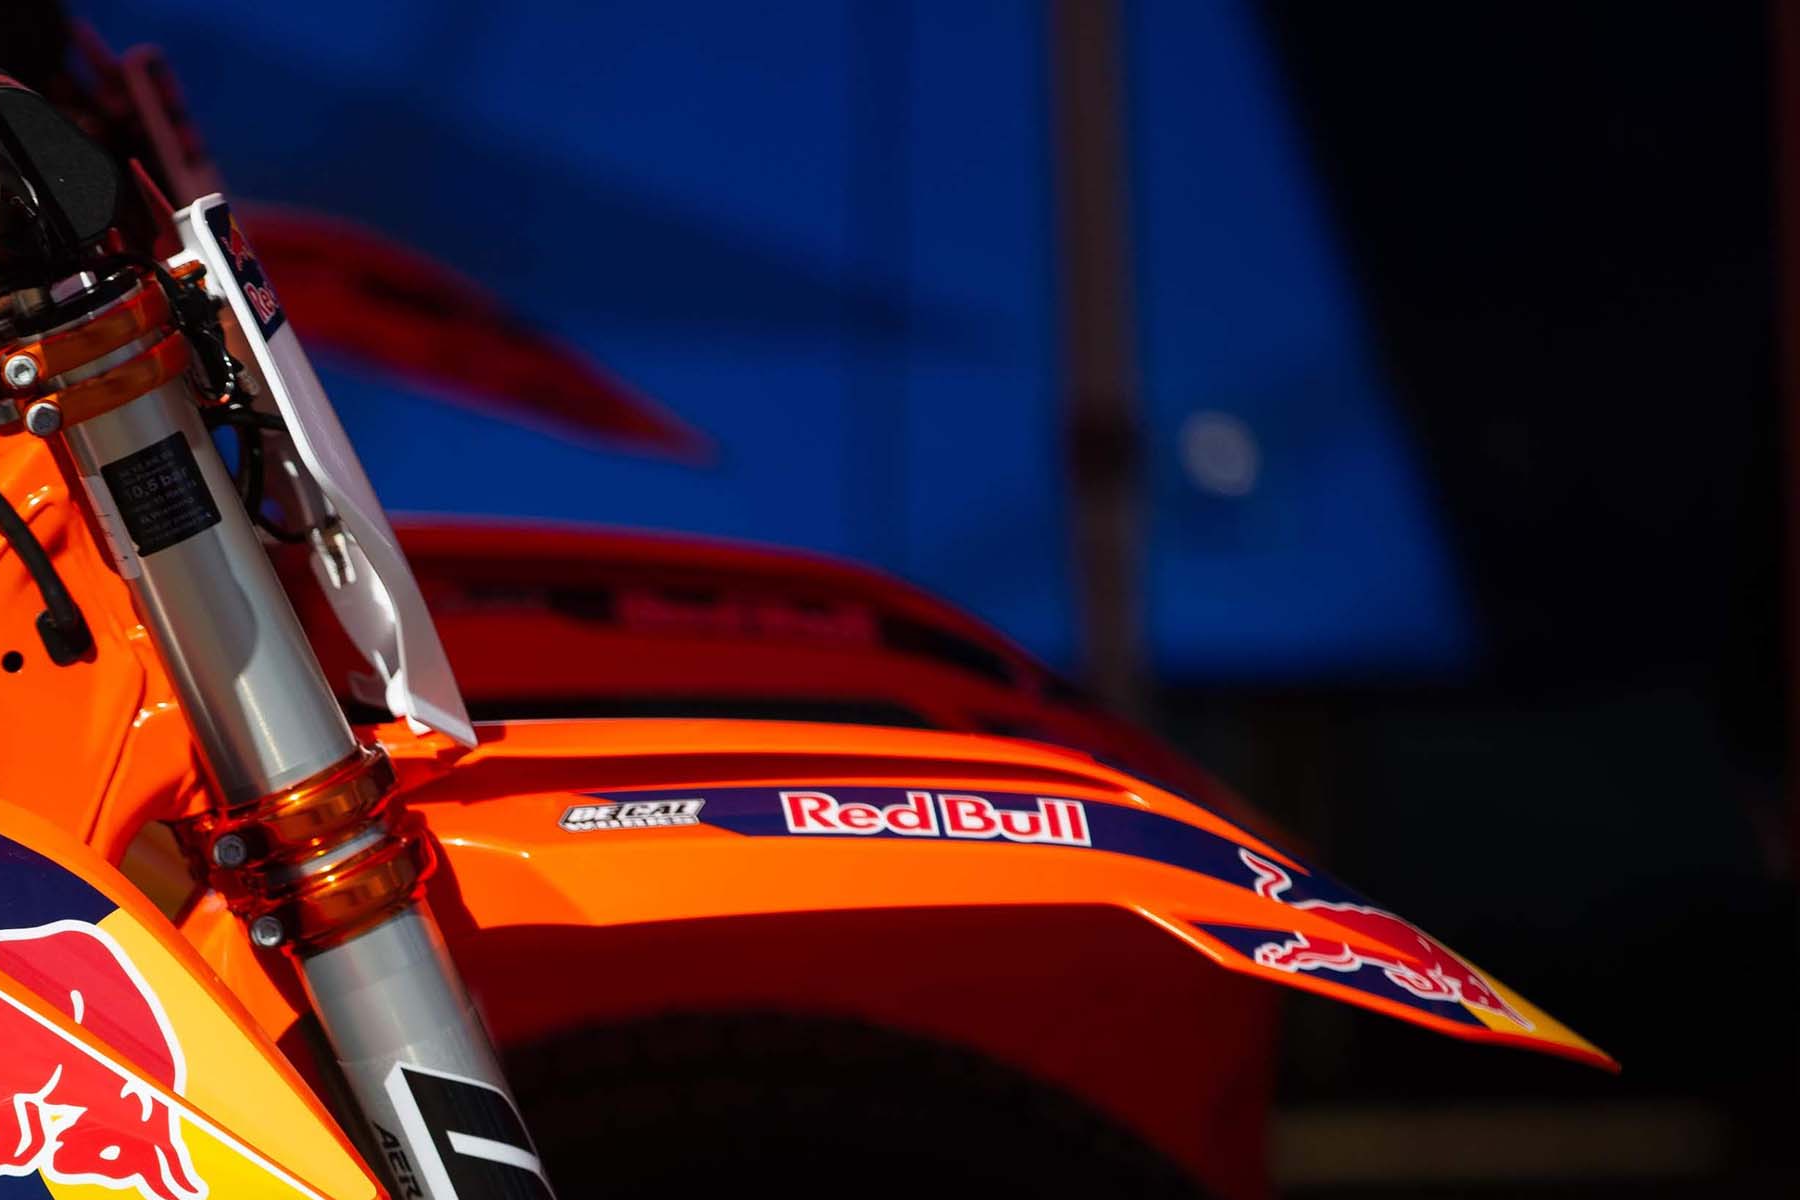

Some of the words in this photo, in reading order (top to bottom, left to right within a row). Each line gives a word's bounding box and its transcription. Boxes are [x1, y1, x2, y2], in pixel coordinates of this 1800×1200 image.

[782, 793, 937, 834] Red
[941, 796, 1088, 844] Bull
[371, 1120, 423, 1200] AER
